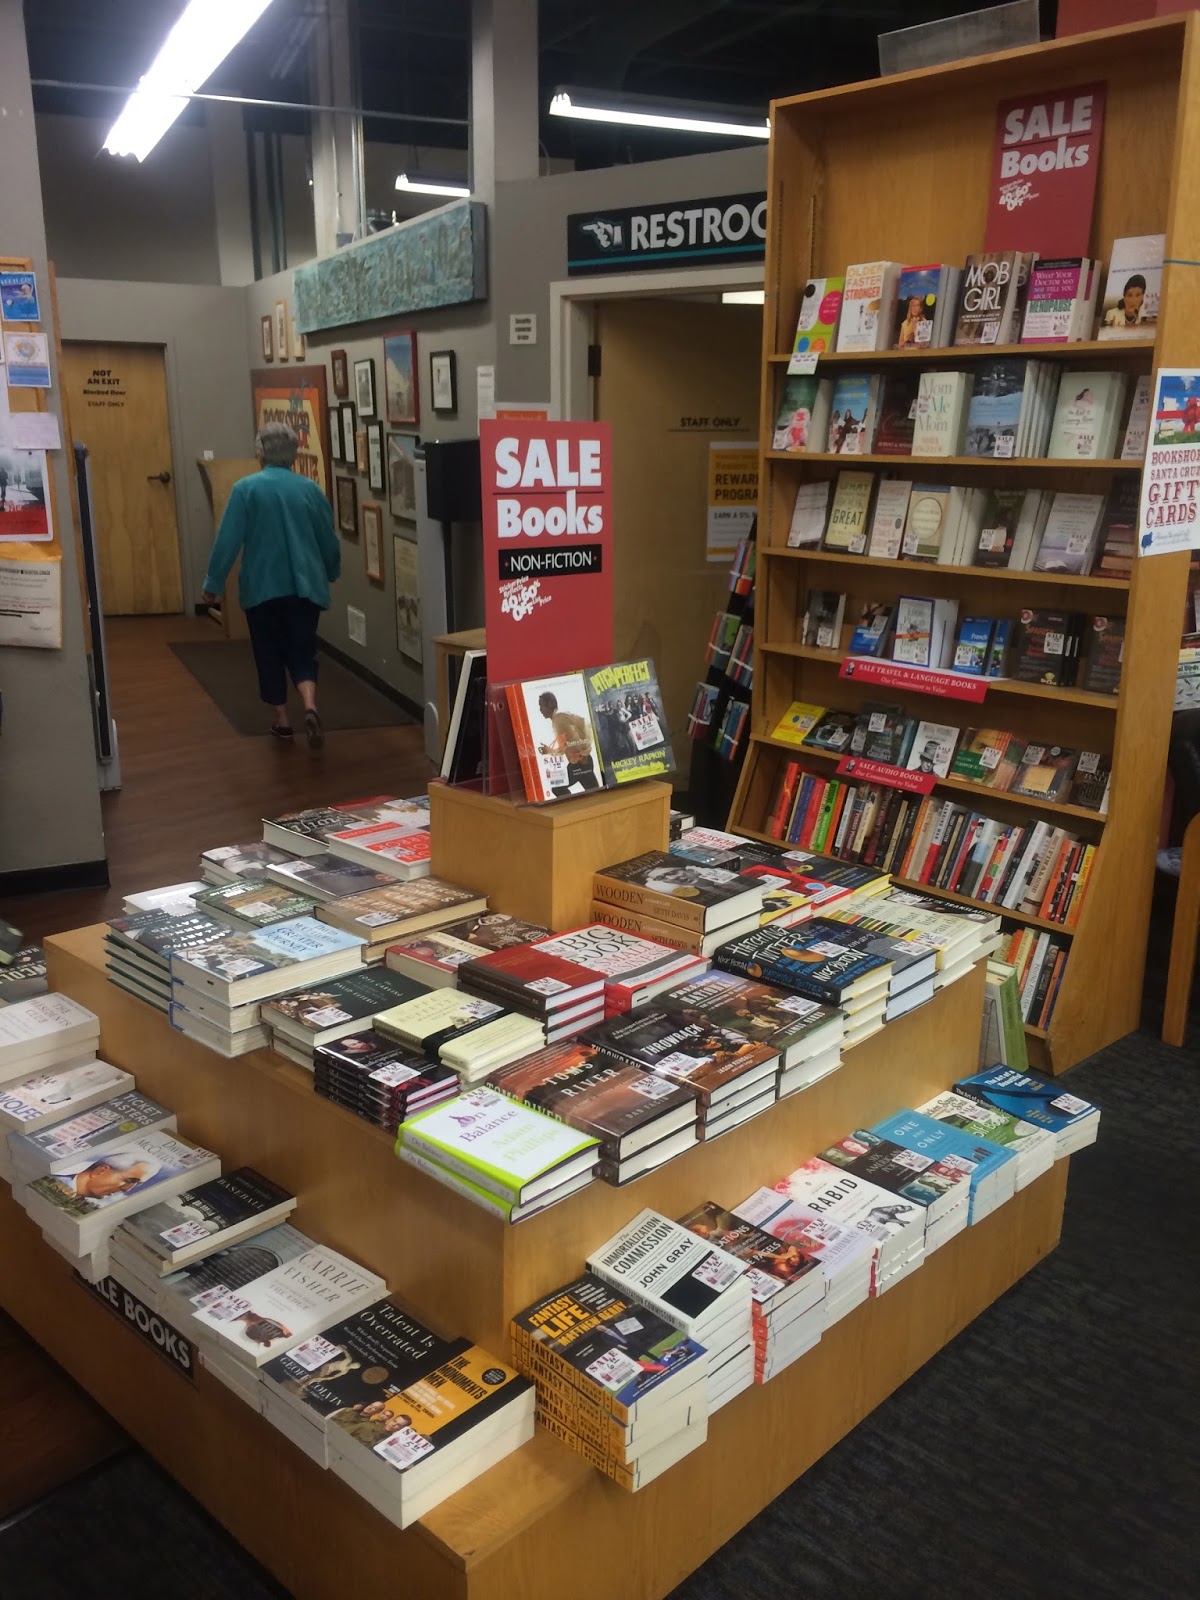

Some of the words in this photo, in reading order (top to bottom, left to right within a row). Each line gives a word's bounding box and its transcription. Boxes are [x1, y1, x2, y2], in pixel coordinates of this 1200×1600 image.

[1003, 96, 1093, 144] SALE
[1001, 136, 1089, 178] Books
[847, 275, 883, 287] FASTER
[965, 261, 1010, 288] MOB
[963, 287, 1001, 312] GIRL
[680, 417, 710, 427] STAFF
[712, 417, 740, 427] ONLY
[495, 437, 602, 489] SALE
[1151, 467, 1178, 480] SANTA
[497, 489, 603, 538] Books
[832, 508, 864, 526] GREAT
[1146, 502, 1197, 528] CARDS
[510, 551, 592, 572] NON-FICTION
[859, 664, 876, 673] SALE
[876, 667, 902, 678] TRAVEL
[910, 673, 951, 687] LANGUAGE
[951, 680, 977, 690] BOOKS
[611, 757, 638, 770] MICKEY
[639, 749, 667, 763] RAPKIN
[859, 762, 877, 770] SALE
[877, 766, 899, 777] AUDIO
[899, 772, 924, 782] BOOKS
[596, 884, 644, 904] WOODEN
[653, 906, 671, 917] SETH
[671, 911, 690, 921] DAVIS
[944, 902, 997, 918] TRANSLATION
[277, 926, 323, 949] GREATER
[555, 928, 615, 950] BIG
[594, 911, 642, 932] WOODEN
[668, 938, 688, 949] DAVIS
[725, 924, 788, 956] HATCHING
[594, 943, 657, 966] SMALL
[752, 932, 808, 964] TWITTER
[812, 963, 834, 982] NICK
[669, 975, 720, 999] FREEDOM
[640, 1023, 705, 1056] THROWBACK
[786, 1021, 804, 1036] JAMES
[541, 1060, 595, 1086] TOMS
[561, 1067, 621, 1098] RIVER
[123, 1093, 162, 1117] TICKET
[625, 1107, 641, 1120] DAN
[459, 1109, 519, 1143] Balance
[893, 1121, 920, 1136] ONE
[917, 1129, 947, 1149] ONLY
[217, 1178, 265, 1210] BASEBALL
[807, 1177, 859, 1213] RABID
[803, 1217, 826, 1235] SALE
[602, 1216, 662, 1268] IMMORTALIZATION
[612, 1223, 674, 1275] COMMISSION
[753, 1241, 782, 1261] PAGELS
[299, 1252, 369, 1296] CARRIE
[639, 1261, 668, 1289] JOHN
[667, 1237, 695, 1264] GRAY
[694, 1253, 721, 1277] SALE
[283, 1267, 341, 1304] FISHER
[229, 1293, 252, 1311] SALE
[528, 1295, 574, 1328] FANTASY
[124, 1292, 191, 1369] BOOKS
[378, 1303, 420, 1337] Talent
[420, 1335, 436, 1349] Is
[540, 1304, 590, 1339] LIFE
[558, 1318, 600, 1347] MATTHEW
[599, 1300, 628, 1321] BERRY
[312, 1336, 338, 1355] SALE
[360, 1311, 428, 1361] Overrated
[280, 1357, 310, 1382] GEOFF
[451, 1356, 471, 1371] THE
[531, 1340, 565, 1374] FANTASY
[587, 1350, 619, 1373] SALE
[424, 1372, 447, 1389] MEN
[437, 1364, 488, 1400] MONUMENTS
[530, 1357, 563, 1390] FANTASY
[404, 1427, 433, 1452] SALE
